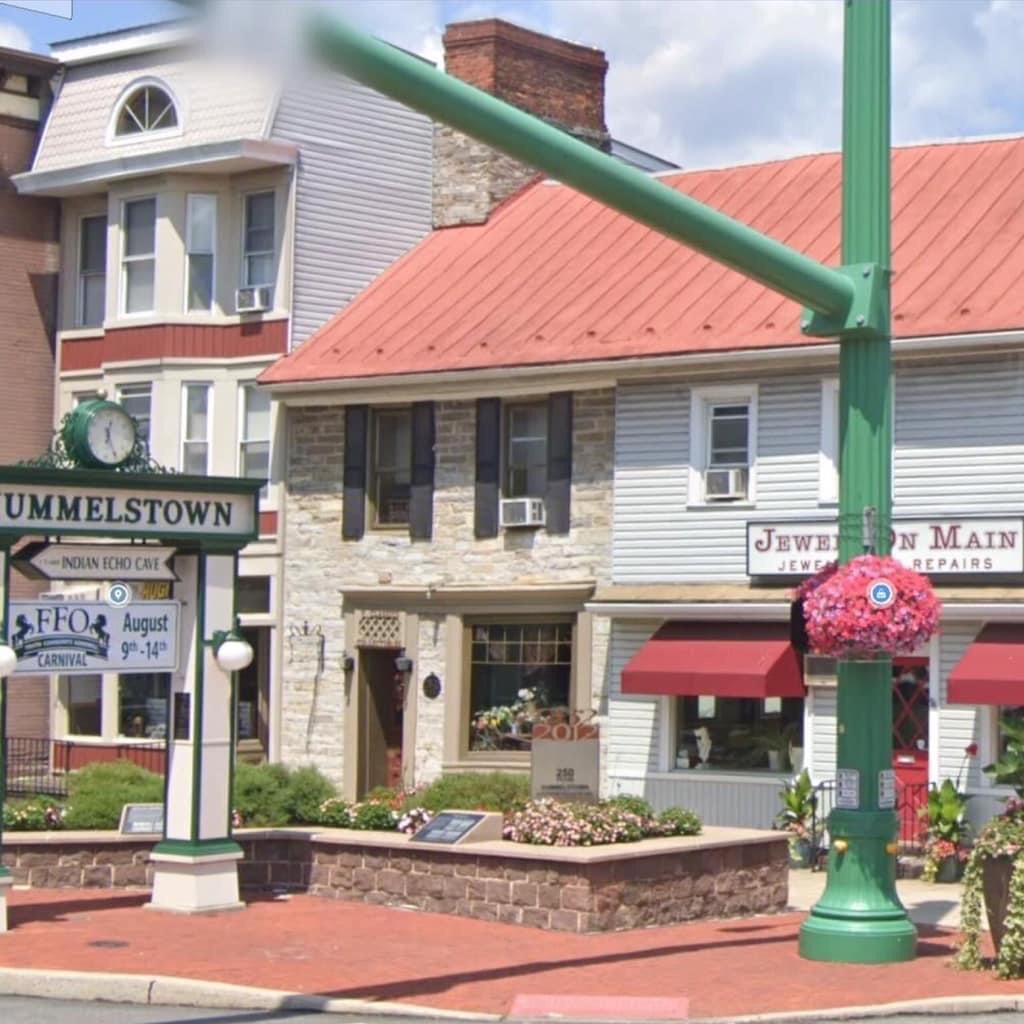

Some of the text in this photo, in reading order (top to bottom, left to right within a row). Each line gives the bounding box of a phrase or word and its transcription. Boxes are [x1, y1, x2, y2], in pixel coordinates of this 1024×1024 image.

[0, 491, 233, 527] UMMELSTOWN
[61, 556, 100, 571] INDIAN
[103, 556, 132, 571] ECHO
[135, 557, 160, 572] CAVE
[913, 558, 994, 570] REPAIRS
[36, 606, 90, 634] FFO
[122, 613, 169, 637] August
[37, 652, 88, 668] CARNIVAL
[532, 722, 598, 743] 2012
